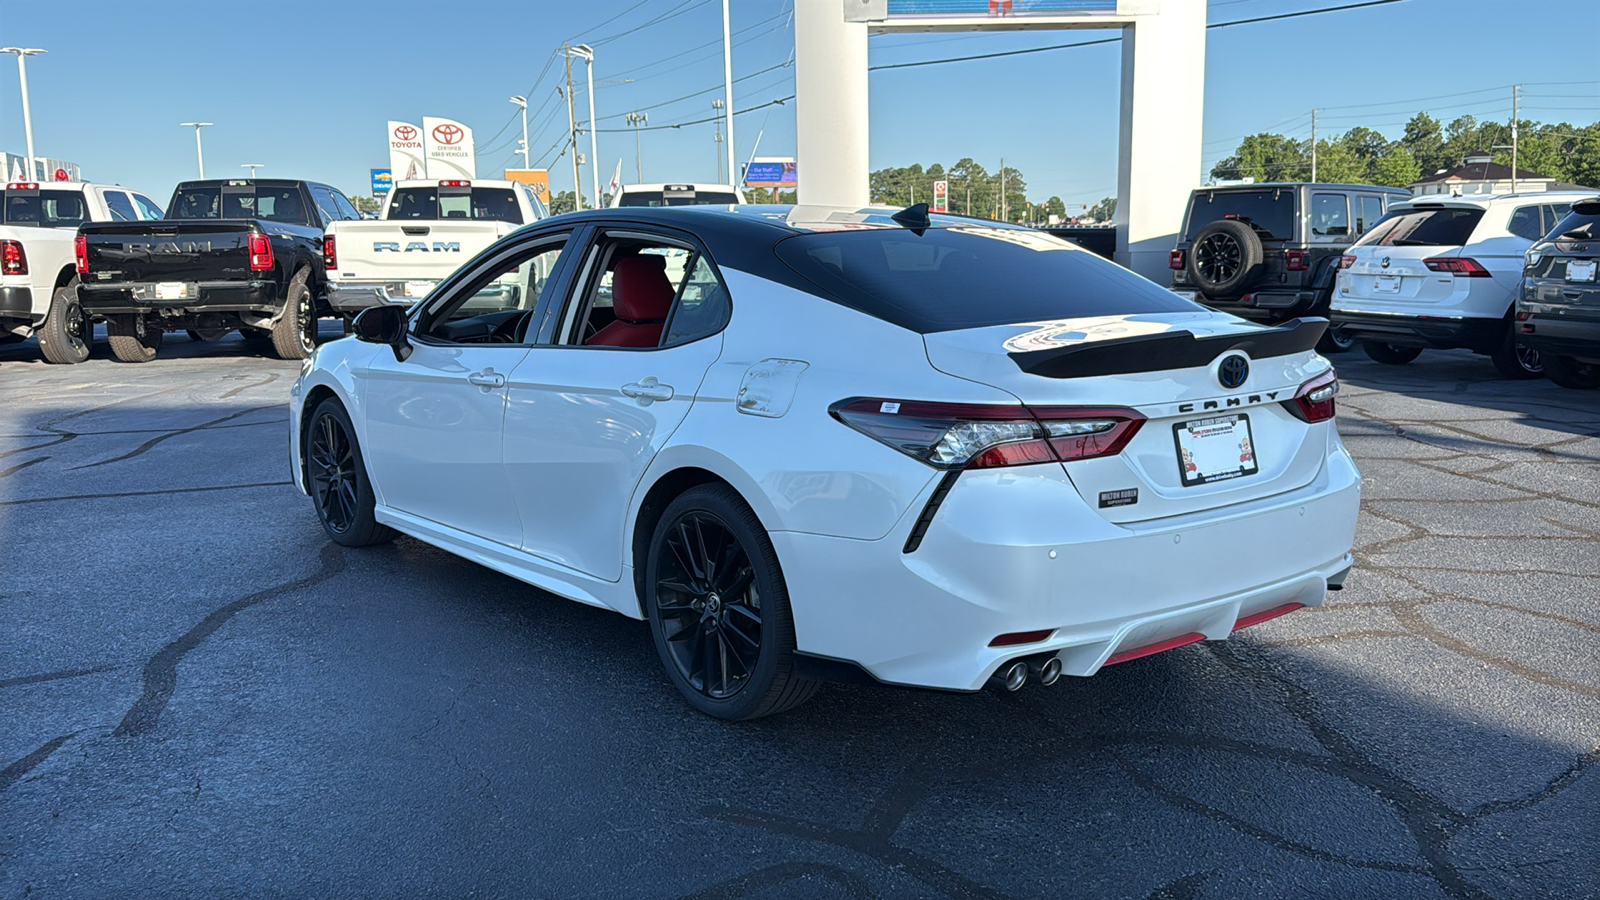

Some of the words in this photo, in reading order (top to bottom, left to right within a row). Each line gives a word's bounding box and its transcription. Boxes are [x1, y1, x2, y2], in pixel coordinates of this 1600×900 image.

[391, 141, 422, 149] TOYOTA
[123, 241, 211, 254] RAM
[373, 242, 461, 253] RAM
[1179, 391, 1279, 413] CAMRY
[1101, 492, 1120, 501] MILTON
[1121, 490, 1137, 498] RUBEN
